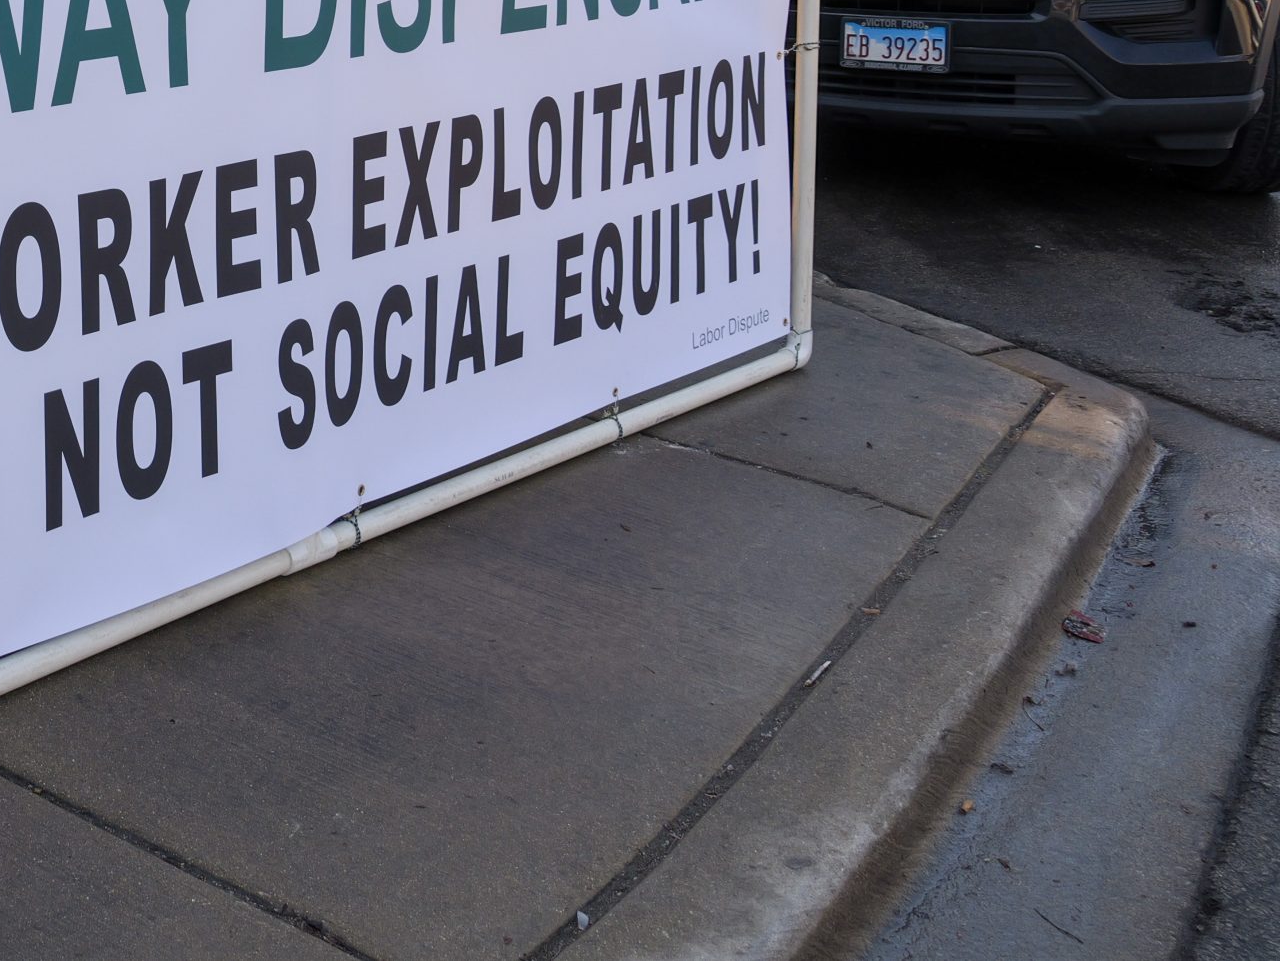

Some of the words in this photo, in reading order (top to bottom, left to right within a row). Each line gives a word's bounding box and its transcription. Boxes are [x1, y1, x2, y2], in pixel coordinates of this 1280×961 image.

[866, 18, 897, 28] VICTOR
[901, 19, 925, 29] FORD
[846, 33, 869, 58] EB
[881, 36, 943, 62] 39235
[351, 51, 767, 261] EXPLOITATION
[691, 326, 726, 350] Labor
[728, 308, 770, 336] Dispute
[43, 338, 233, 533] NOT
[277, 254, 524, 450] SOCIAL
[553, 178, 761, 347] EQUITY!
